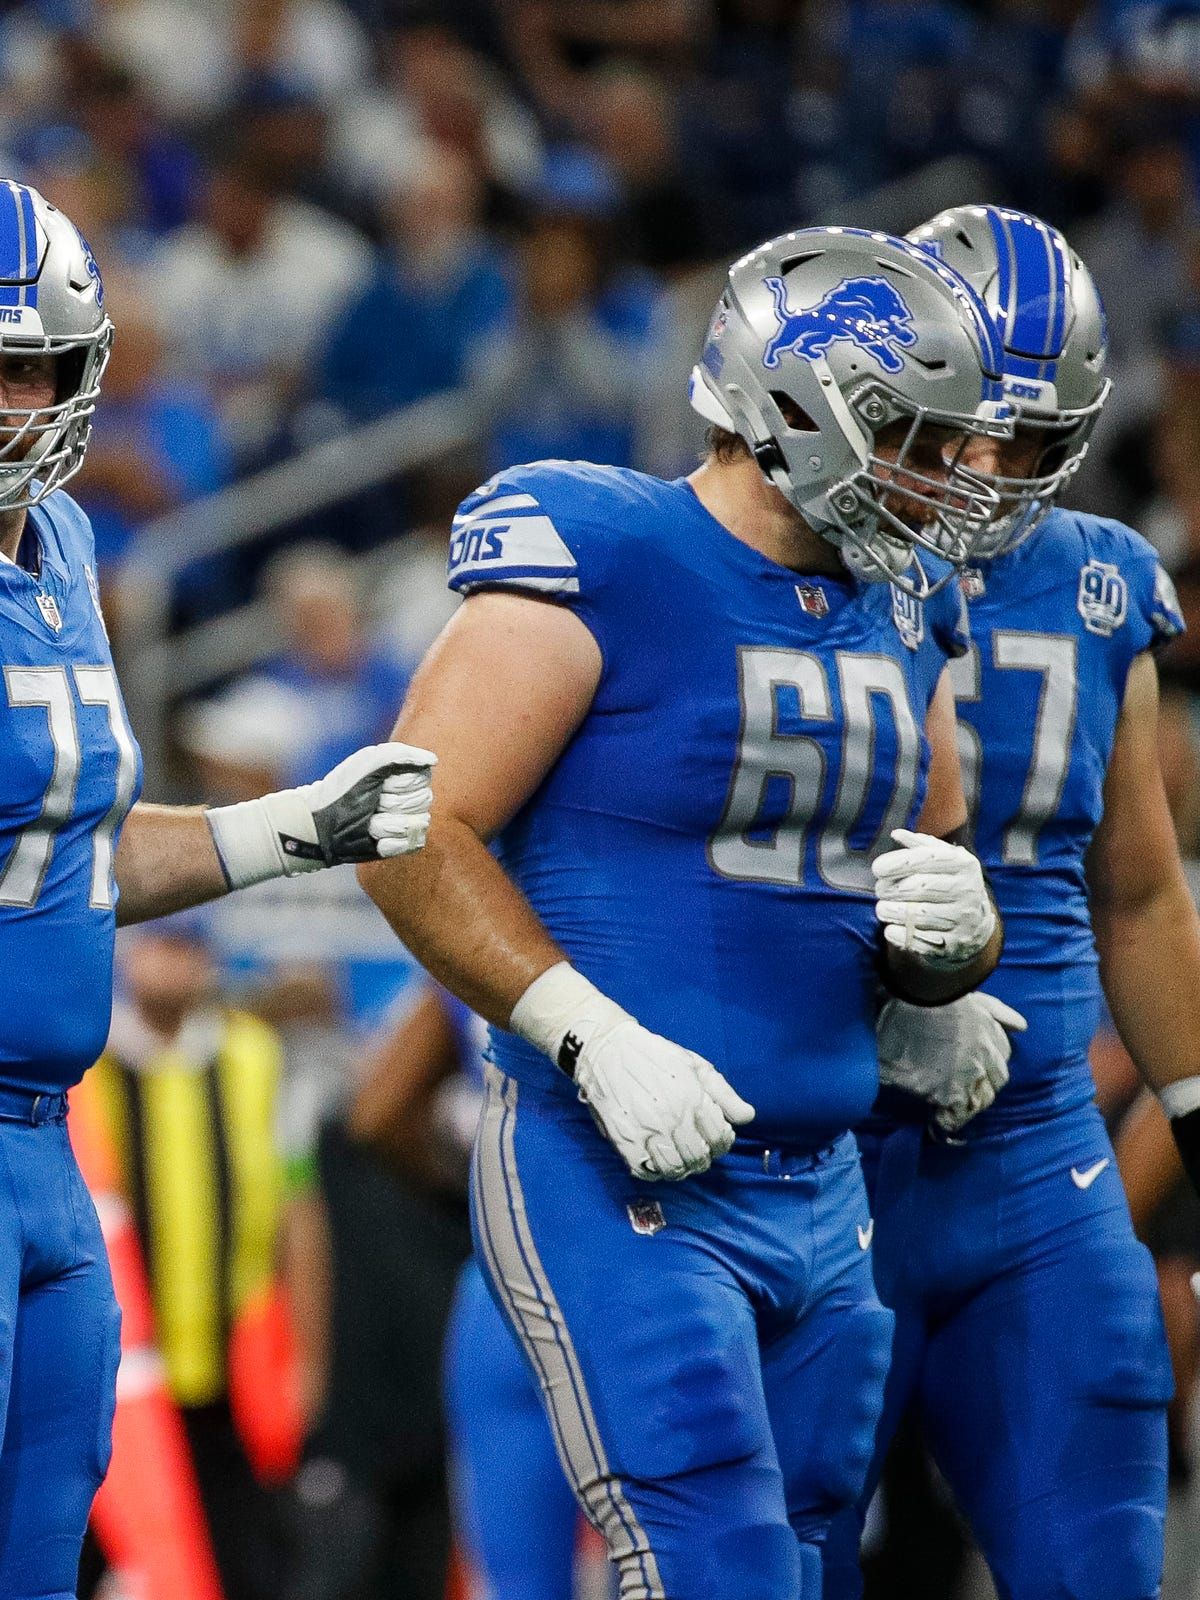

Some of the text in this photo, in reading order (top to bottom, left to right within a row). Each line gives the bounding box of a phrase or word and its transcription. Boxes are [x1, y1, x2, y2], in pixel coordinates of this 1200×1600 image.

[450, 525, 511, 570] ONS
[1084, 569, 1123, 618] 90
[706, 644, 920, 895] 60
